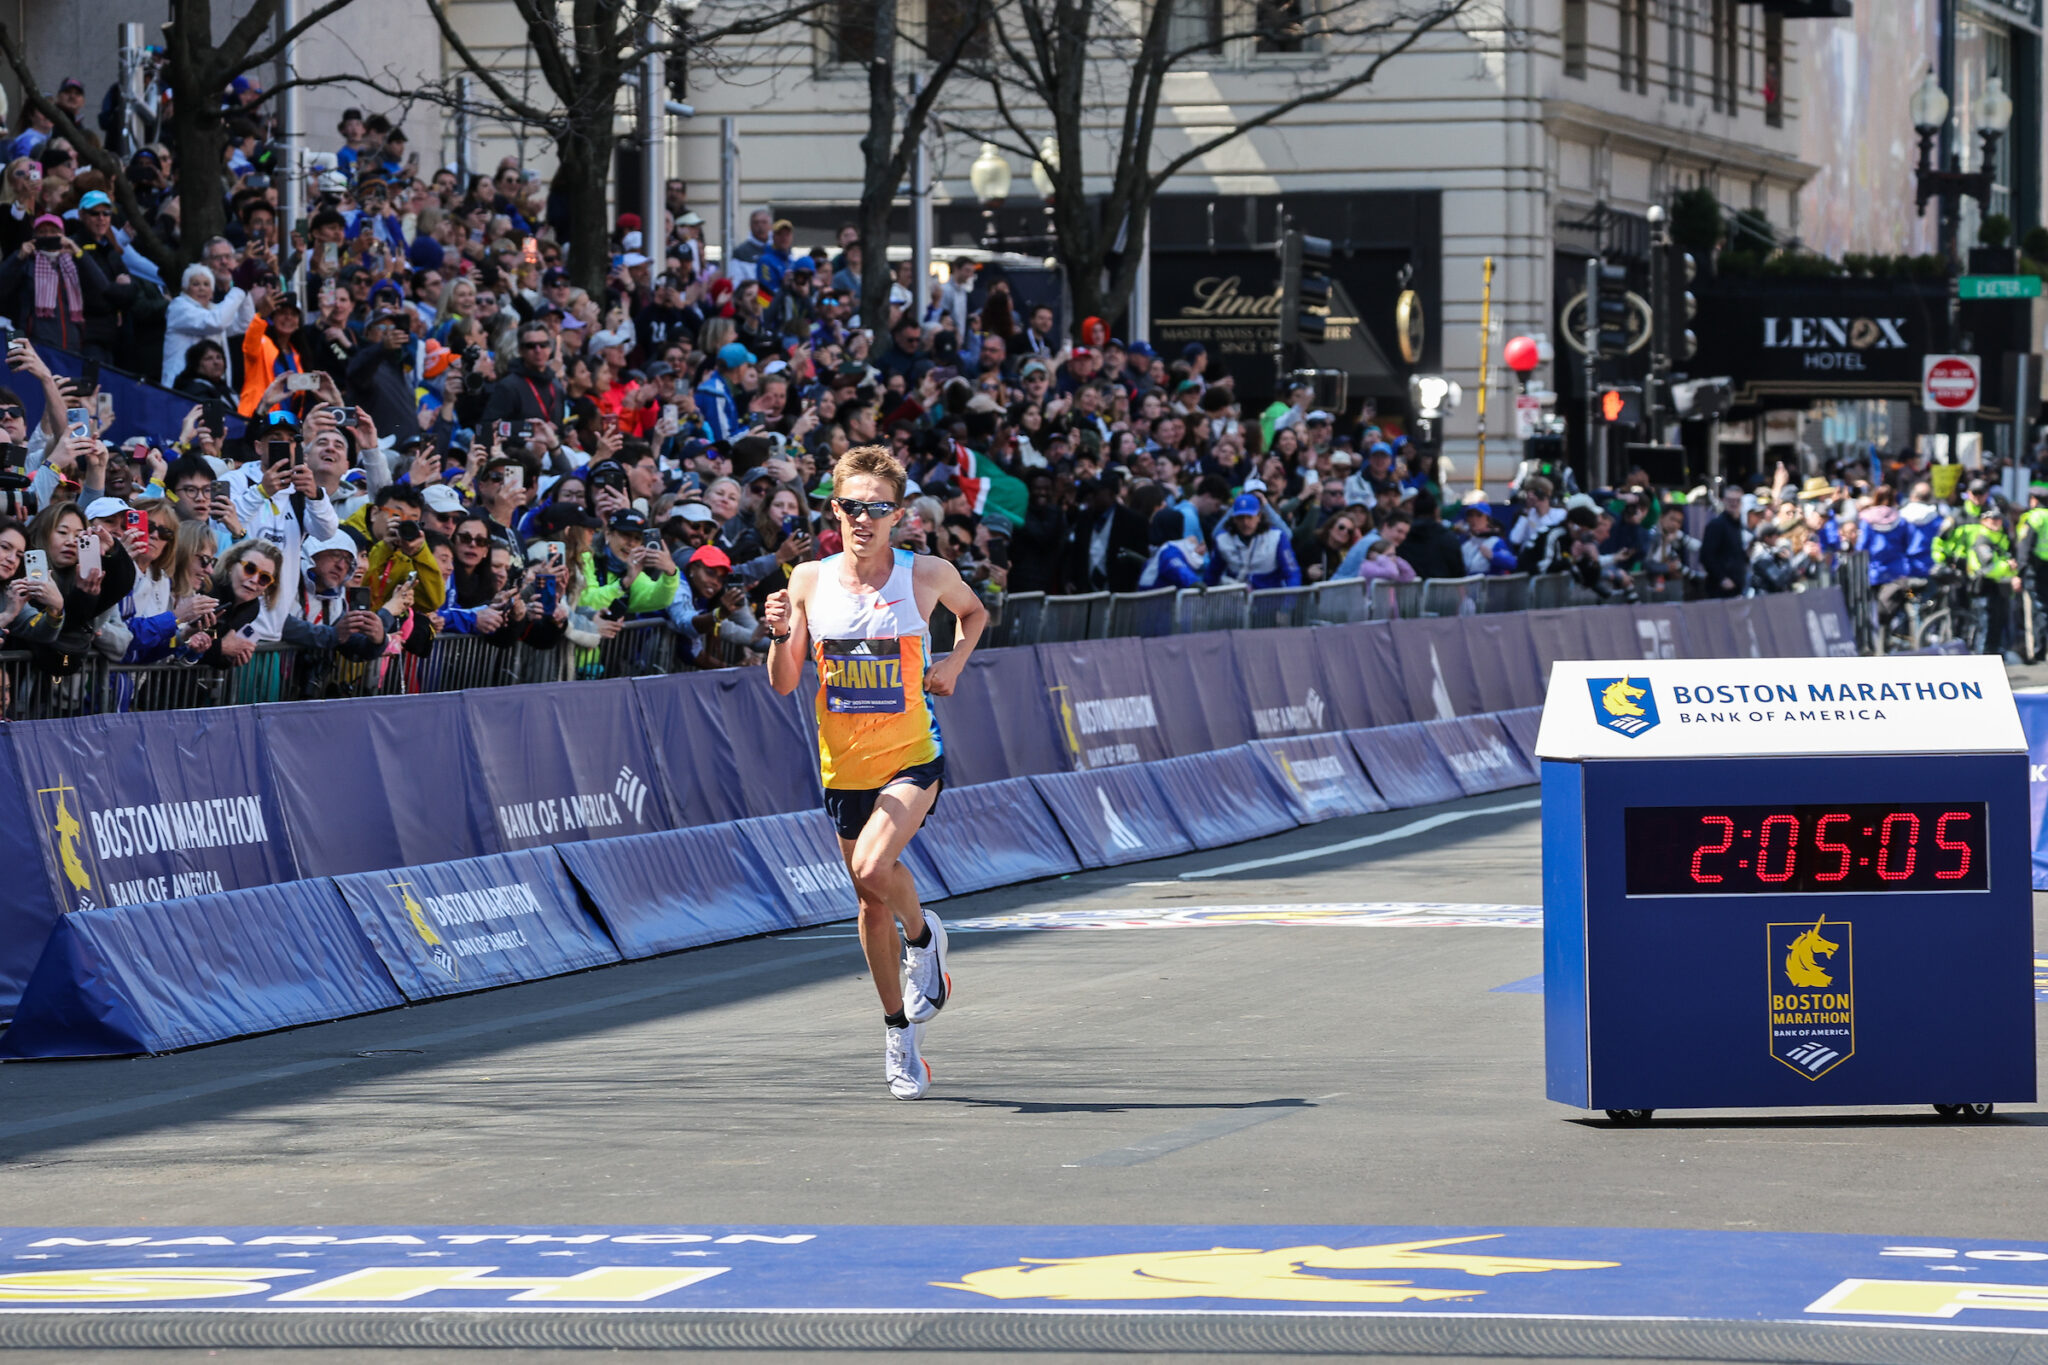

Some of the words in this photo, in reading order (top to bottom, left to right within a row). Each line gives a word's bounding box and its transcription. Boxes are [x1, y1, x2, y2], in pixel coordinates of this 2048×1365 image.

[1976, 280, 2021, 298] EXETER
[1804, 352, 1866, 370] HOTEL
[827, 659, 903, 689] MANTZ
[1673, 684, 1798, 704] BOSTON
[1808, 681, 1983, 702] MARATHON
[1680, 711, 1740, 724] BANK
[1749, 710, 1776, 722] OF
[1784, 709, 1887, 721] AMERICA
[499, 802, 541, 839] BANK
[538, 799, 559, 834] OF
[561, 793, 622, 830] AMERICA
[90, 803, 175, 860] BOSTON
[168, 795, 268, 850] MARATHON
[1690, 811, 1972, 884] 2:05:05
[109, 879, 150, 907] BANK
[147, 876, 168, 902] OF
[172, 870, 223, 899] AMERICA
[425, 891, 484, 927] BOSTON
[471, 882, 543, 920] MARATHON
[488, 929, 528, 951] AMERICA
[1773, 993, 1850, 1011] BOSTON
[1773, 1011, 1851, 1024] MARATHON
[1811, 1028, 1850, 1036] AMERICA
[26, 1232, 818, 1248] MARATHON
